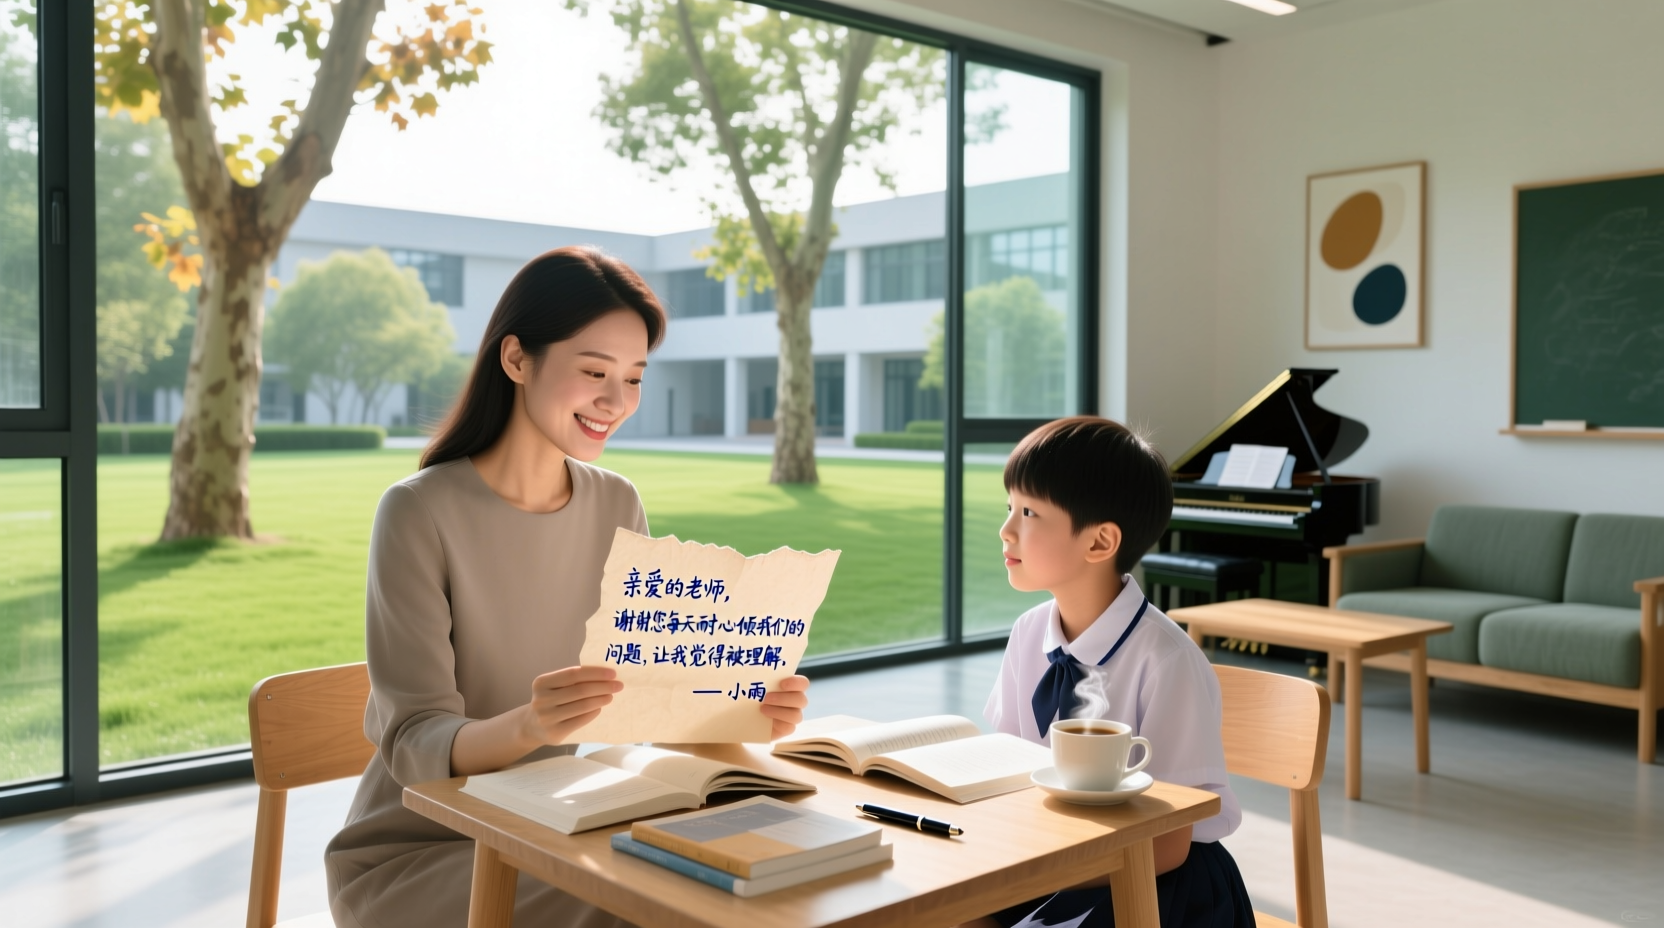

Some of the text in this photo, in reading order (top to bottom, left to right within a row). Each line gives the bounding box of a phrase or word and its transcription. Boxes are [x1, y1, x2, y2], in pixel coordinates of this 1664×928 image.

[622, 567, 731, 603] 亲爱的老师，
